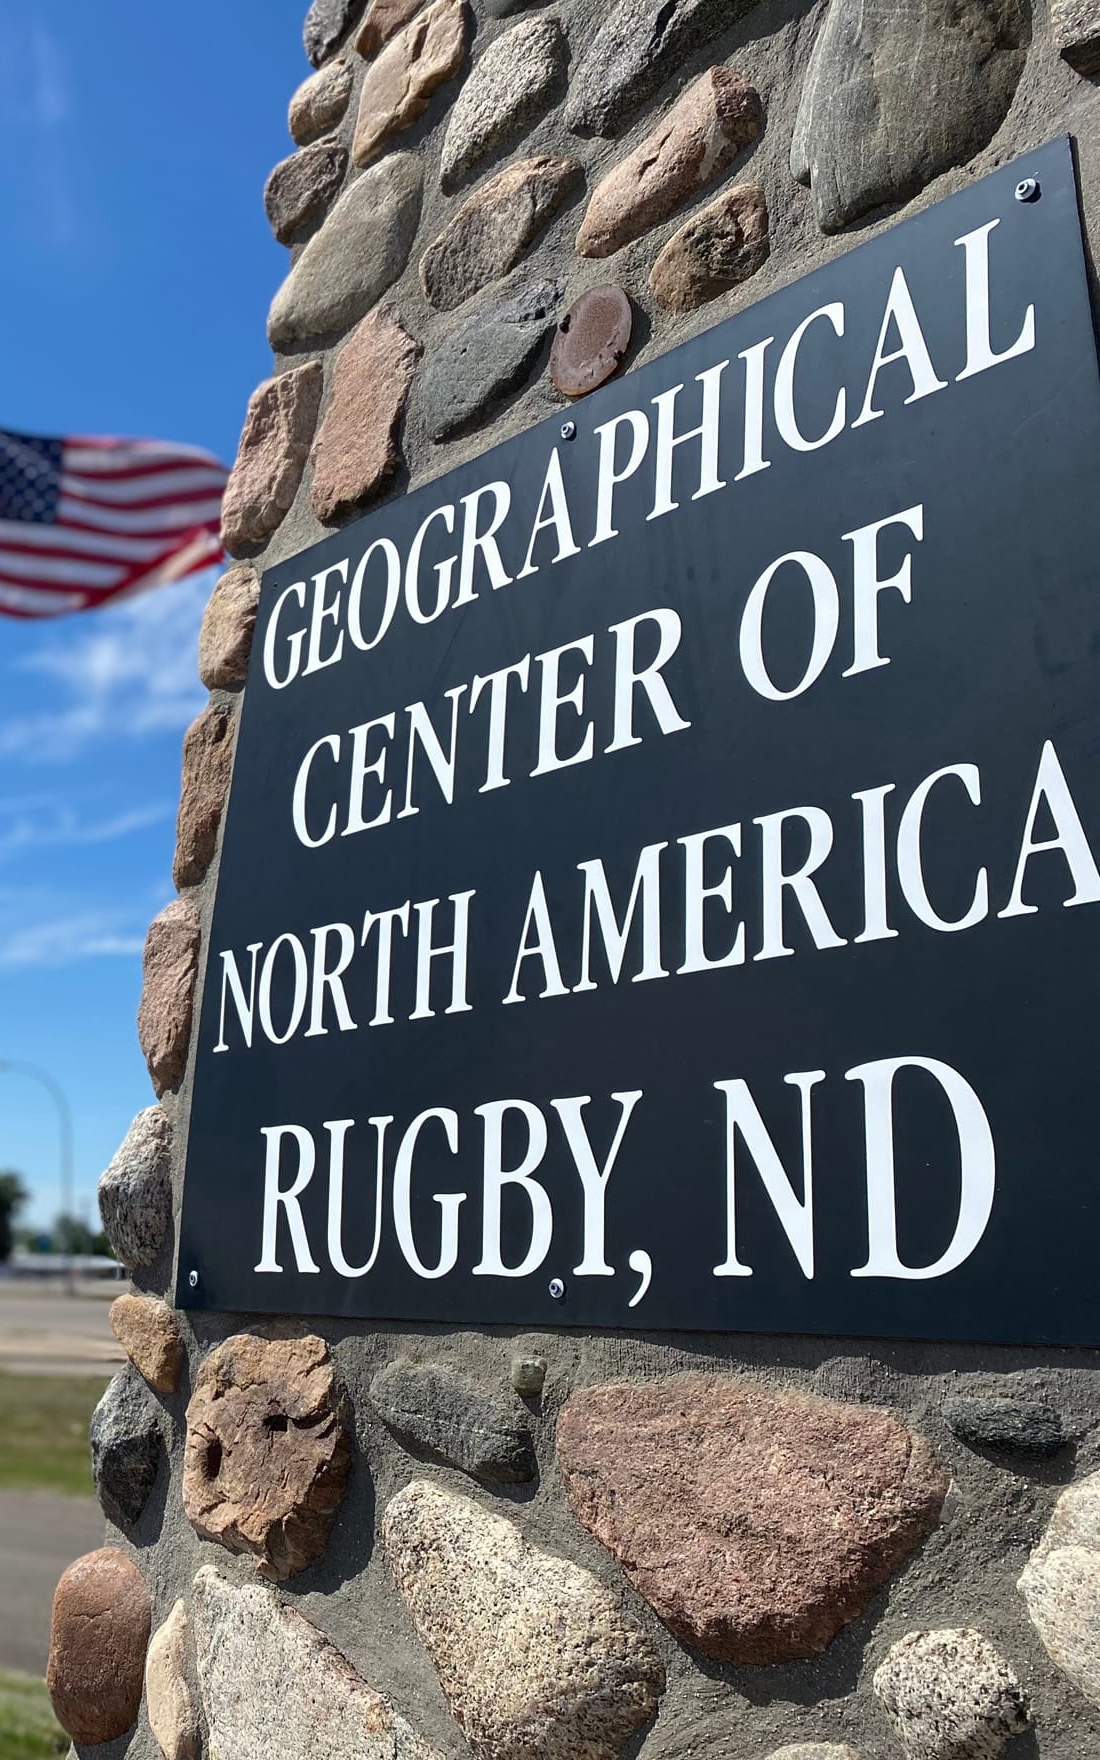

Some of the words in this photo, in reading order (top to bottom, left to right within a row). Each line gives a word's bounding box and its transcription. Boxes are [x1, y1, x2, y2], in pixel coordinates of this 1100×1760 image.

[262, 217, 1037, 692] GEOGRAPHICAL
[291, 607, 693, 849] CENTER
[738, 502, 925, 702] OF
[211, 888, 476, 1054] NORTH
[501, 738, 1100, 1006] AMERICA
[253, 1088, 653, 1309] RUGBY,
[712, 1055, 997, 1281] ND
